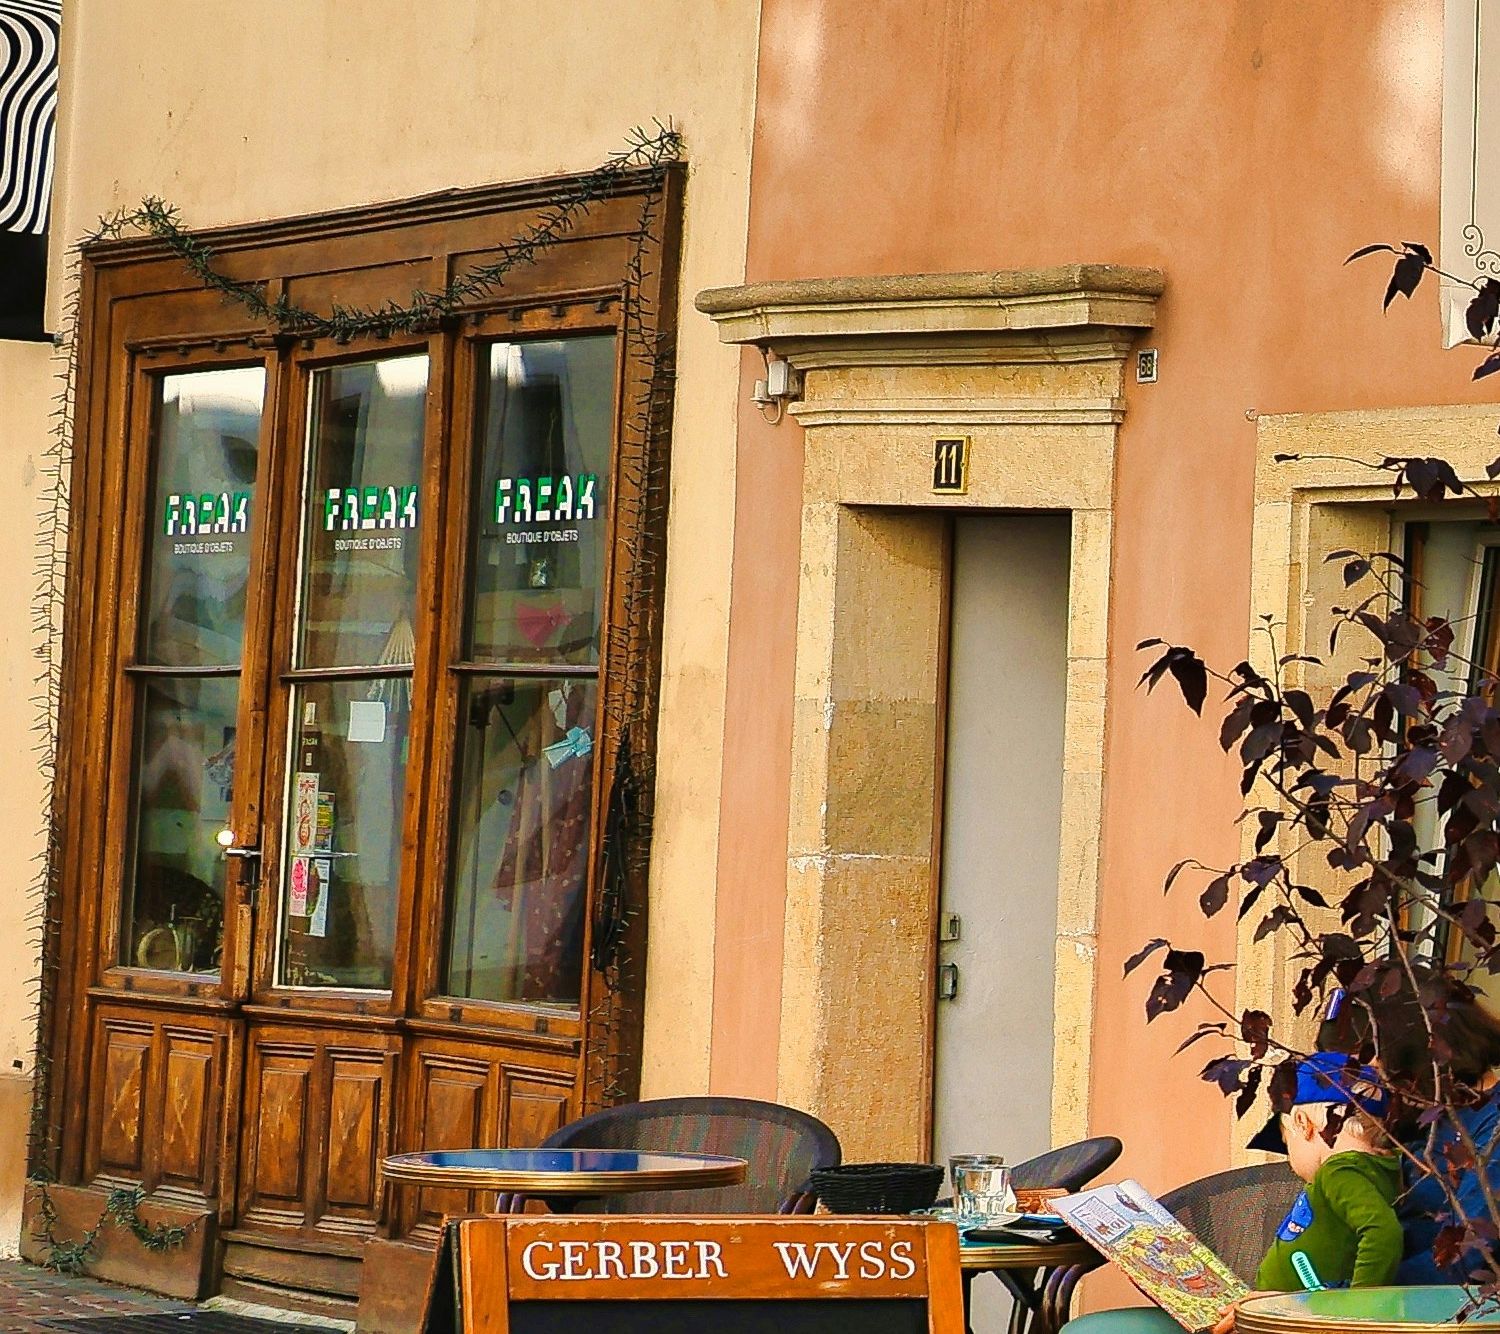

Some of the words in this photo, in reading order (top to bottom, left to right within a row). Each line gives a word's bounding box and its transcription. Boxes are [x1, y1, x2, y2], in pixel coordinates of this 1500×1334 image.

[938, 444, 959, 484] 11
[163, 492, 250, 536] FREAK
[324, 484, 418, 531] FREAK
[494, 473, 598, 524] FREAK
[506, 531, 542, 544] BOUTIQUE
[543, 529, 579, 542] D'OBJETS
[521, 1240, 729, 1281] GERBER
[773, 1241, 916, 1280] WYSS
